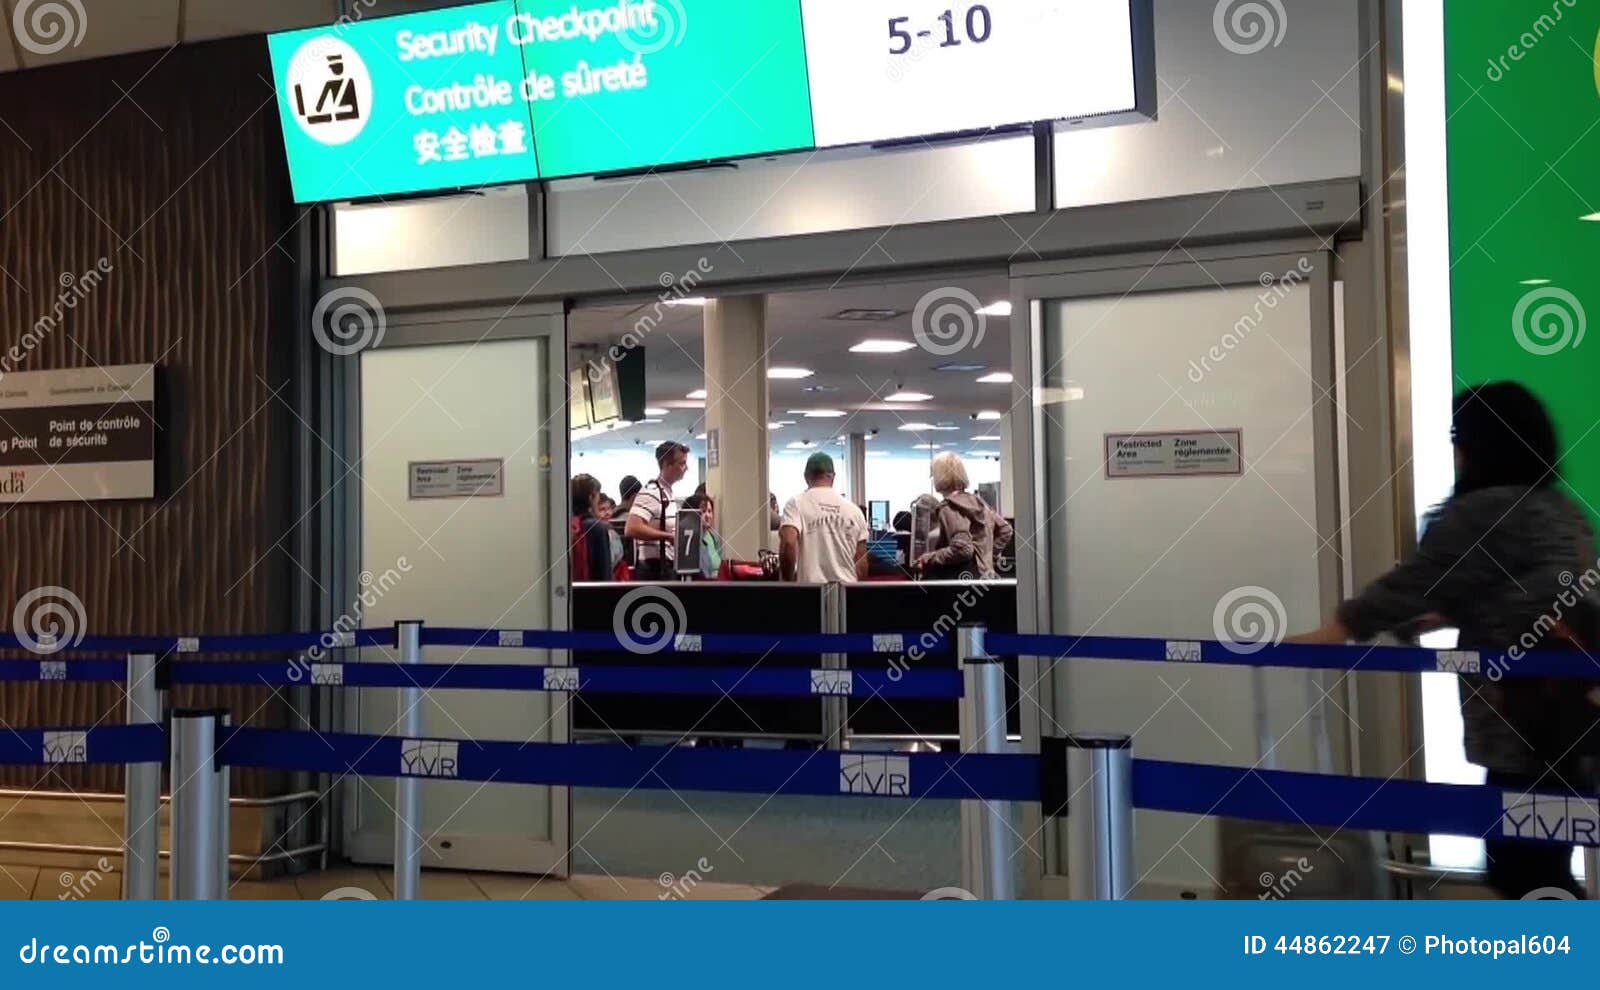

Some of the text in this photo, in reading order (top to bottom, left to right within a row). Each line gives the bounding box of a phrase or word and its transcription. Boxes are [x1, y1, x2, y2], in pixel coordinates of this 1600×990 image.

[396, 0, 658, 62] Security Checkpoint
[888, 4, 992, 54] 5-10
[404, 51, 648, 116] Contrôle de sûreté
[50, 416, 140, 432] Point de contrôle
[12, 437, 38, 449] Point
[50, 433, 108, 447] de sécurité
[1117, 440, 1162, 448] Restricted
[1174, 439, 1197, 447] Zone
[1117, 450, 1137, 458] Area
[684, 529, 694, 556] 7
[1166, 648, 1200, 662] YVR
[1437, 658, 1479, 672] YVR
[812, 680, 852, 694] YVR
[43, 743, 86, 764] YVR
[402, 753, 456, 777] YVR
[842, 769, 909, 797] YVR
[1505, 811, 1598, 843] YVR
